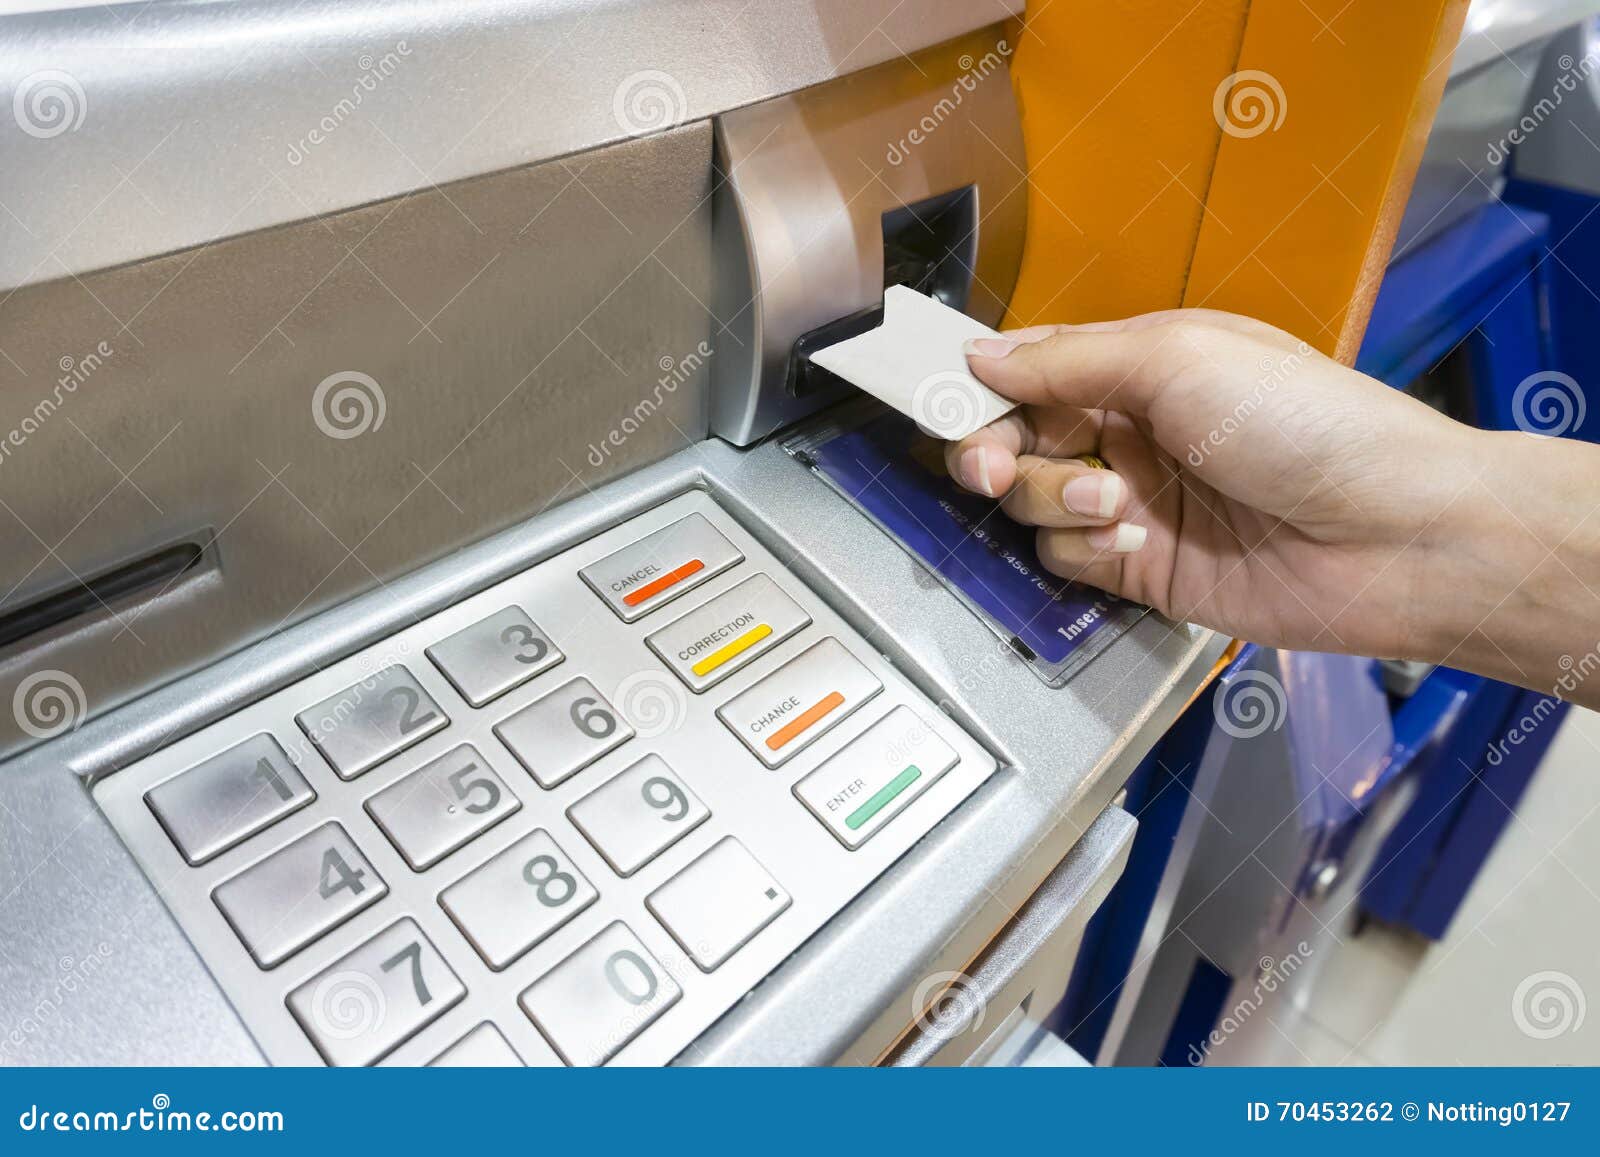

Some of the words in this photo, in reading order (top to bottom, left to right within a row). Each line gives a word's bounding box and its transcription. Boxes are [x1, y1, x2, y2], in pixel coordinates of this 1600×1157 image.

[611, 563, 662, 594] CANCEL
[501, 624, 549, 665] 3
[678, 612, 756, 662] CORRECTION
[1057, 601, 1107, 641] Insert
[381, 685, 438, 736] 2
[569, 696, 617, 740] 6
[750, 695, 802, 735] CHANGE
[253, 756, 295, 802] 1
[447, 762, 502, 815] 5
[640, 776, 690, 823] 9
[825, 777, 868, 813] ENTER
[317, 846, 367, 901] 4
[522, 854, 578, 908] 8
[379, 940, 434, 1007] 7
[603, 949, 659, 1006] 0
